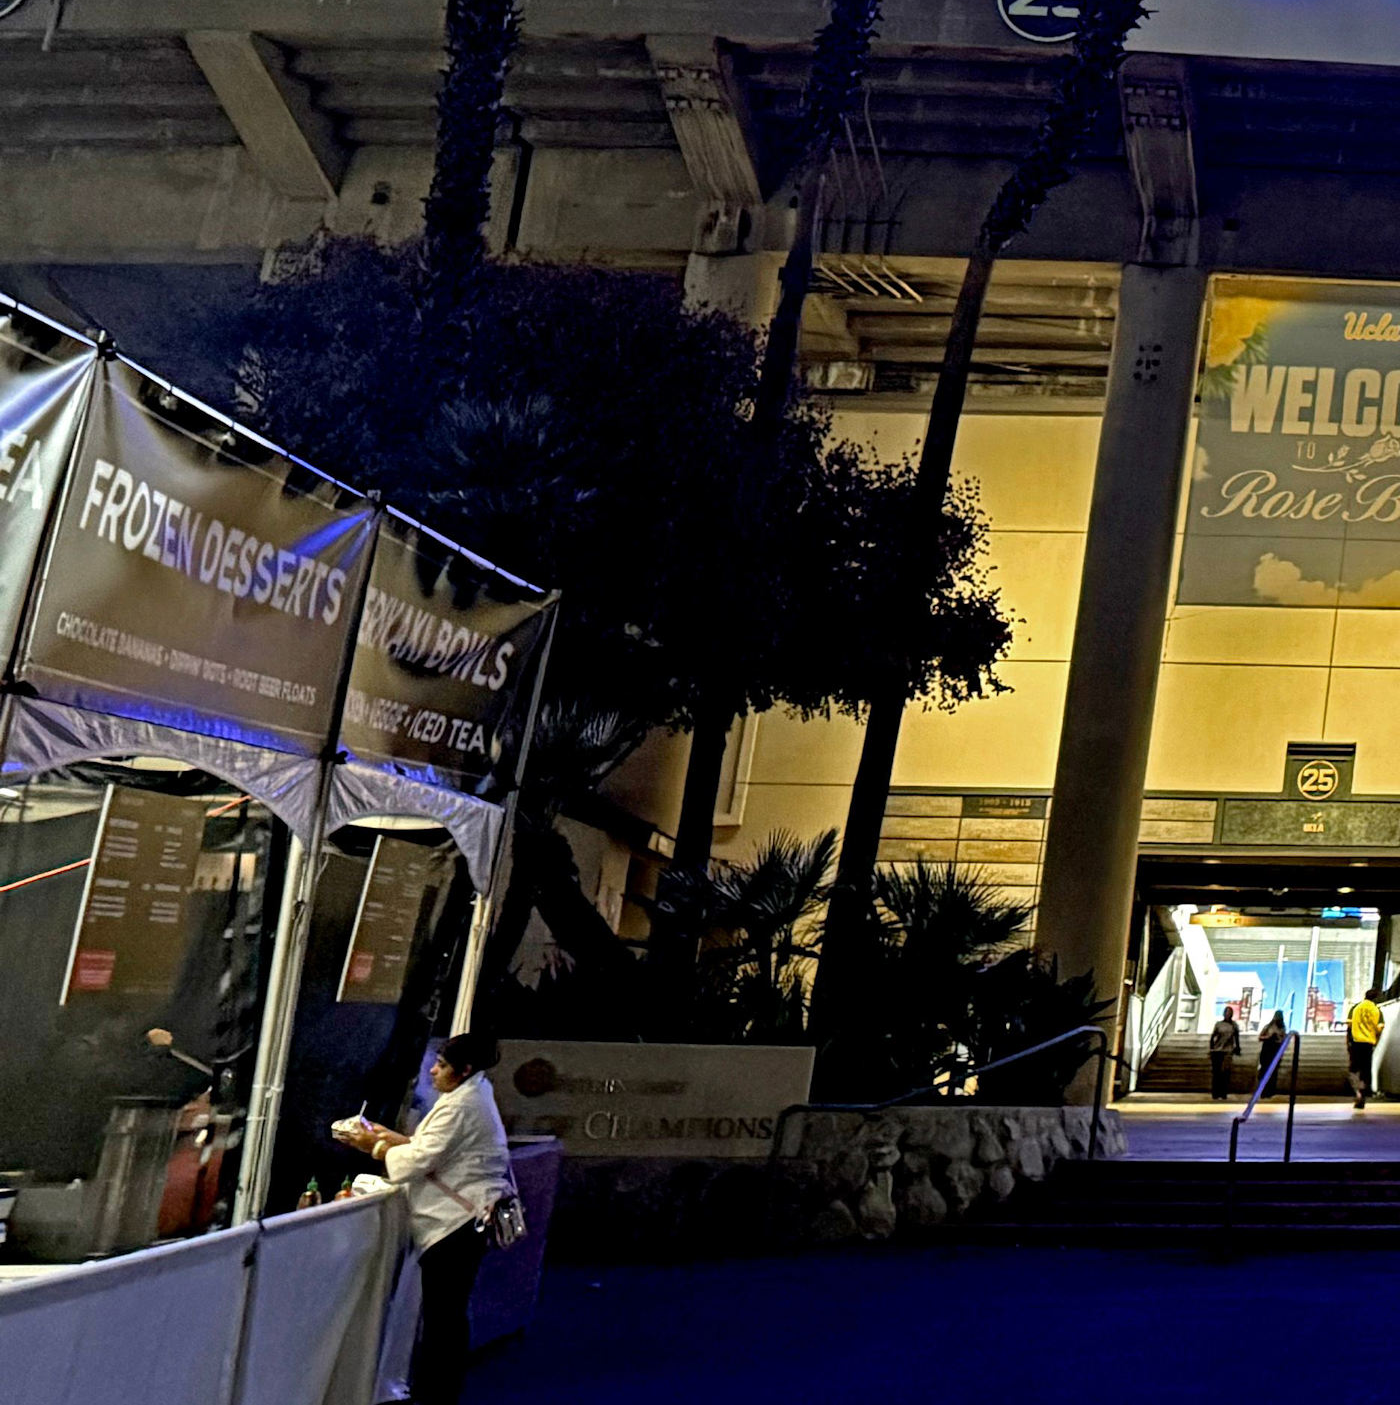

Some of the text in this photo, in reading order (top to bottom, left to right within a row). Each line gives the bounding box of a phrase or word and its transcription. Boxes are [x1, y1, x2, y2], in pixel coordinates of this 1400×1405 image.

[1296, 441, 1316, 460] TO
[1200, 469, 1344, 520] Rose
[80, 459, 347, 626] FROZEN DESSERTS
[57, 611, 120, 653] CHOCOLATE
[281, 680, 317, 706] FLOATS
[358, 584, 514, 691] ERIYAKI BOWLS
[407, 708, 448, 744] ICED
[448, 719, 485, 754] TEA
[1302, 768, 1335, 792] 25
